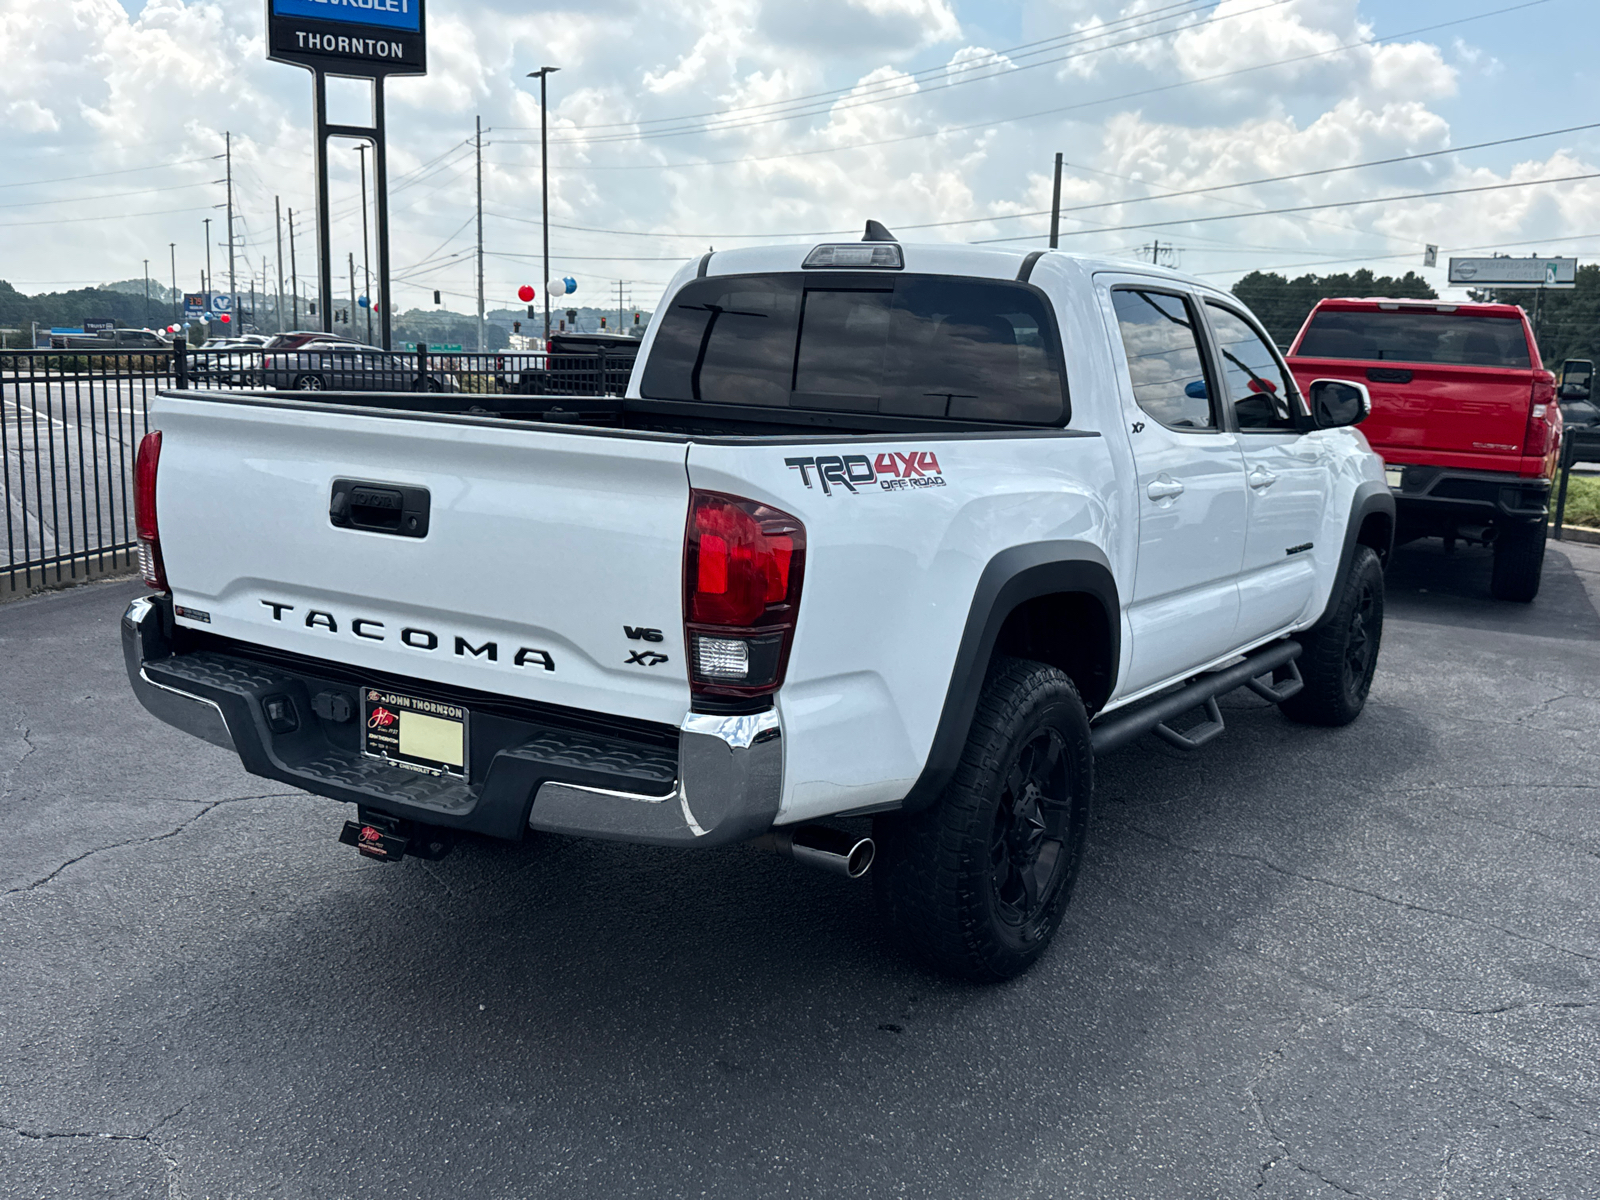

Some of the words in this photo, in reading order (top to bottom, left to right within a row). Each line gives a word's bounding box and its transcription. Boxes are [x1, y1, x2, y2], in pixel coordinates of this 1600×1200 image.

[296, 31, 403, 59] THORNTON
[1131, 421, 1145, 434] XP
[784, 454, 878, 496] TRD
[880, 480, 909, 491] OFF
[908, 476, 946, 490] ROAD
[352, 491, 395, 508] TOYOTA
[259, 599, 556, 672] TACOMA
[623, 625, 664, 642] V6
[624, 650, 669, 667] XP
[385, 694, 410, 707] JOHN
[412, 699, 462, 718] THORNTON
